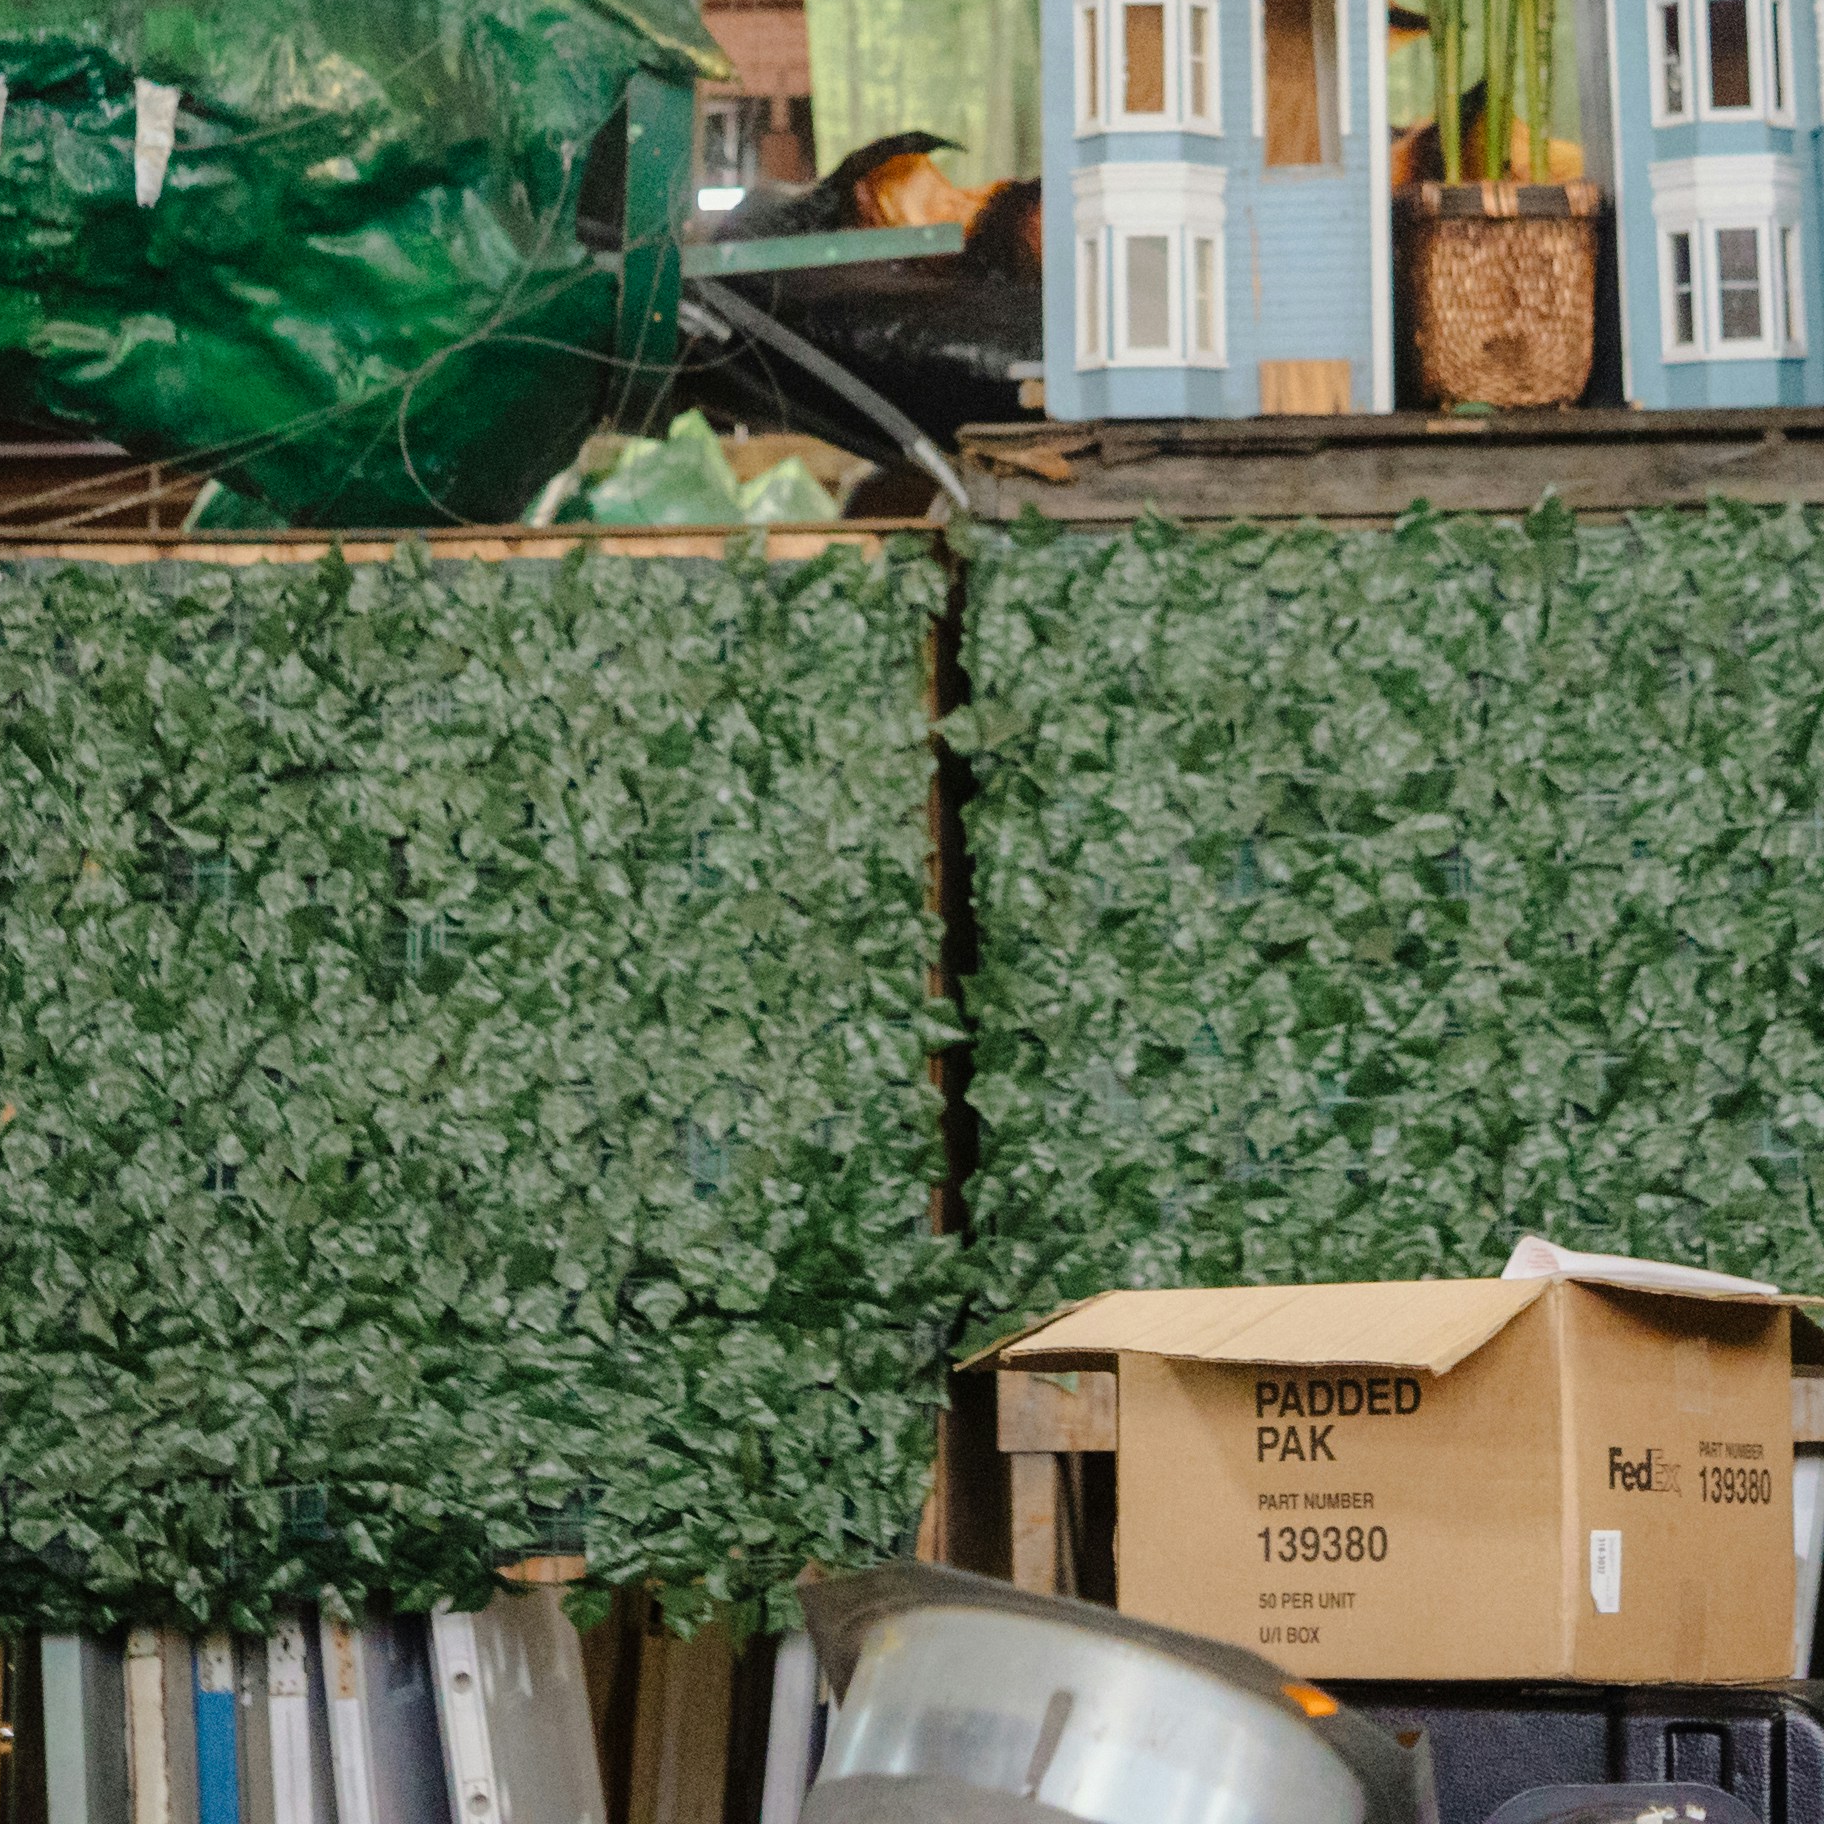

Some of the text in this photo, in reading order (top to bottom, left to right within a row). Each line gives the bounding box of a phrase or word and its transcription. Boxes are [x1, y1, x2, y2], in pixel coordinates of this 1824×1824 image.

[1256, 1377, 1422, 1419] PADDED
[1256, 1424, 1337, 1463] PAK
[1699, 1440, 1764, 1460] PART NUMBER
[1608, 1446, 1683, 1498] FedEx
[1699, 1465, 1773, 1505] 139380
[1258, 1492, 1375, 1511] PART NUMBER
[1257, 1526, 1389, 1563] 139380
[1258, 1592, 1357, 1610] 50 PER UNIT
[1286, 1626, 1321, 1644] BOX
